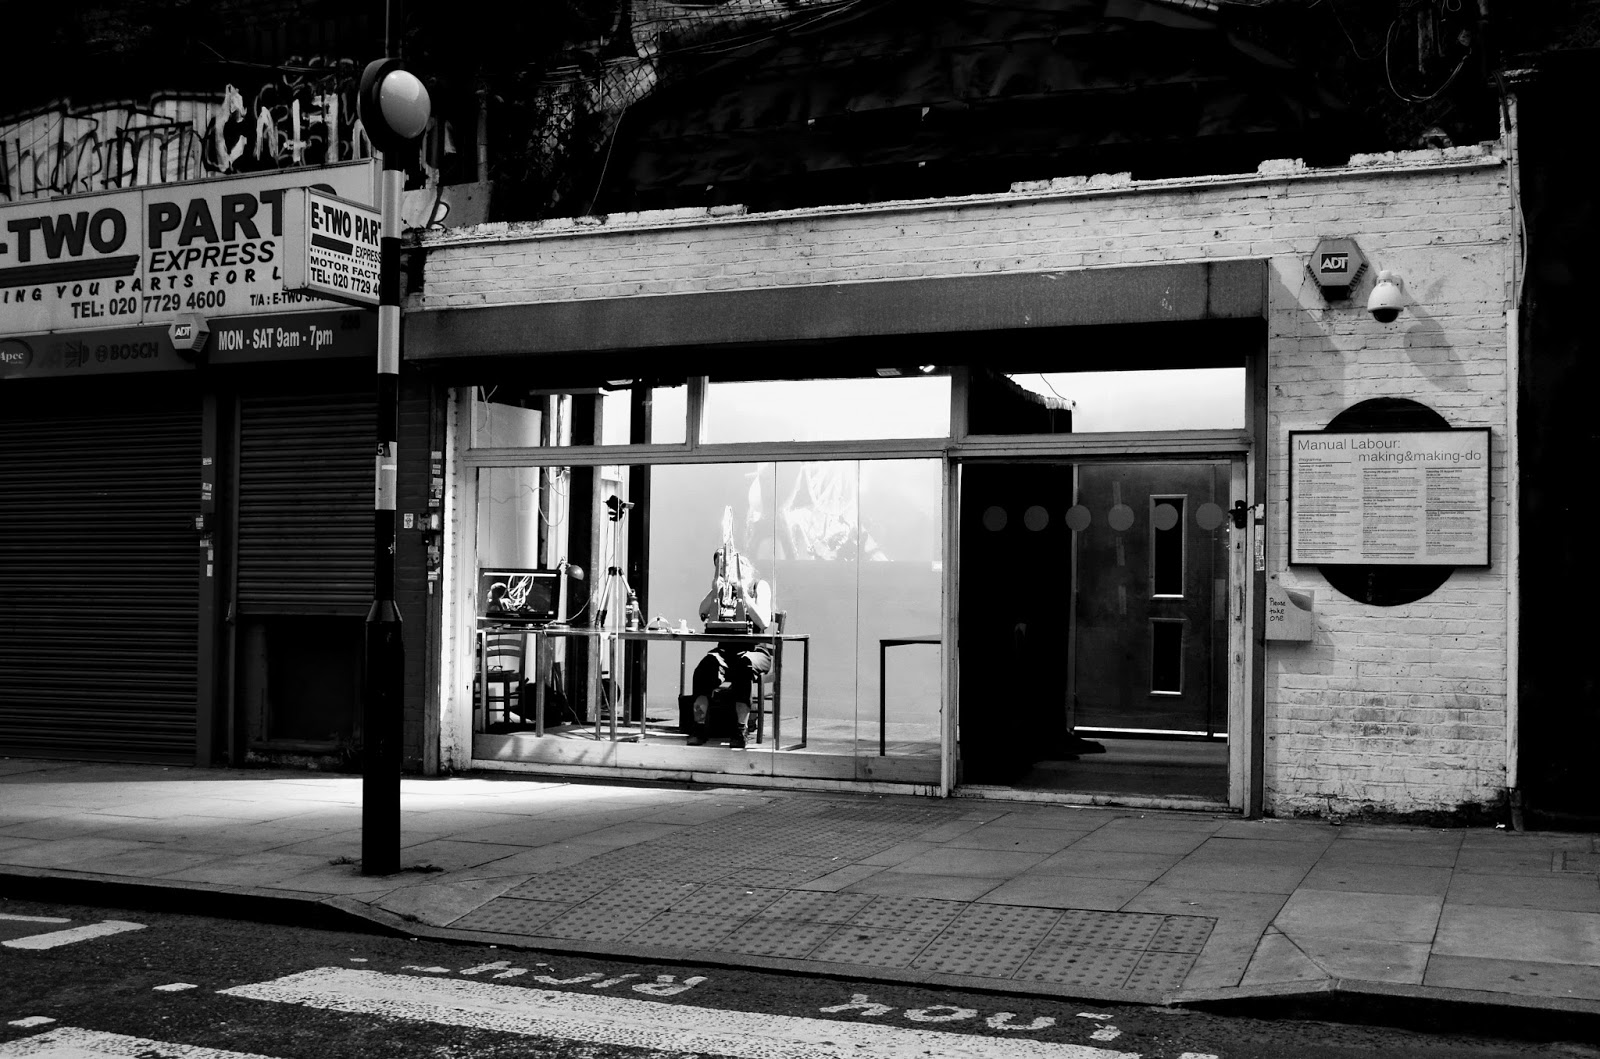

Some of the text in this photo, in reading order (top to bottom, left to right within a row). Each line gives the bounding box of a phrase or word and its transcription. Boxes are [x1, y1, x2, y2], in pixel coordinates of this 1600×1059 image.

[148, 184, 337, 249] PART
[311, 201, 351, 238] E-TWO
[149, 241, 276, 272] EXPRESS
[310, 256, 349, 273] MOTOR
[347, 257, 364, 266] PARTS
[1321, 257, 1348, 269] ADT
[57, 282, 100, 299] YOU
[115, 274, 194, 294] PARTS
[210, 268, 256, 286] FOR
[310, 267, 330, 285] TEL:
[333, 273, 348, 289] 020
[351, 277, 370, 294] 7729
[71, 289, 226, 319] TEL: 020 7729 4600
[273, 292, 302, 304] E-TWO
[175, 327, 191, 337] ADT
[218, 330, 243, 350] MON
[253, 328, 274, 349] SAT
[276, 327, 299, 347] 9am
[310, 325, 333, 350] 7pm
[110, 342, 158, 360] BOSCH
[1298, 438, 1400, 451] Manual Labour:
[1358, 450, 1481, 464] making&making-do
[1269, 597, 1286, 606] Please
